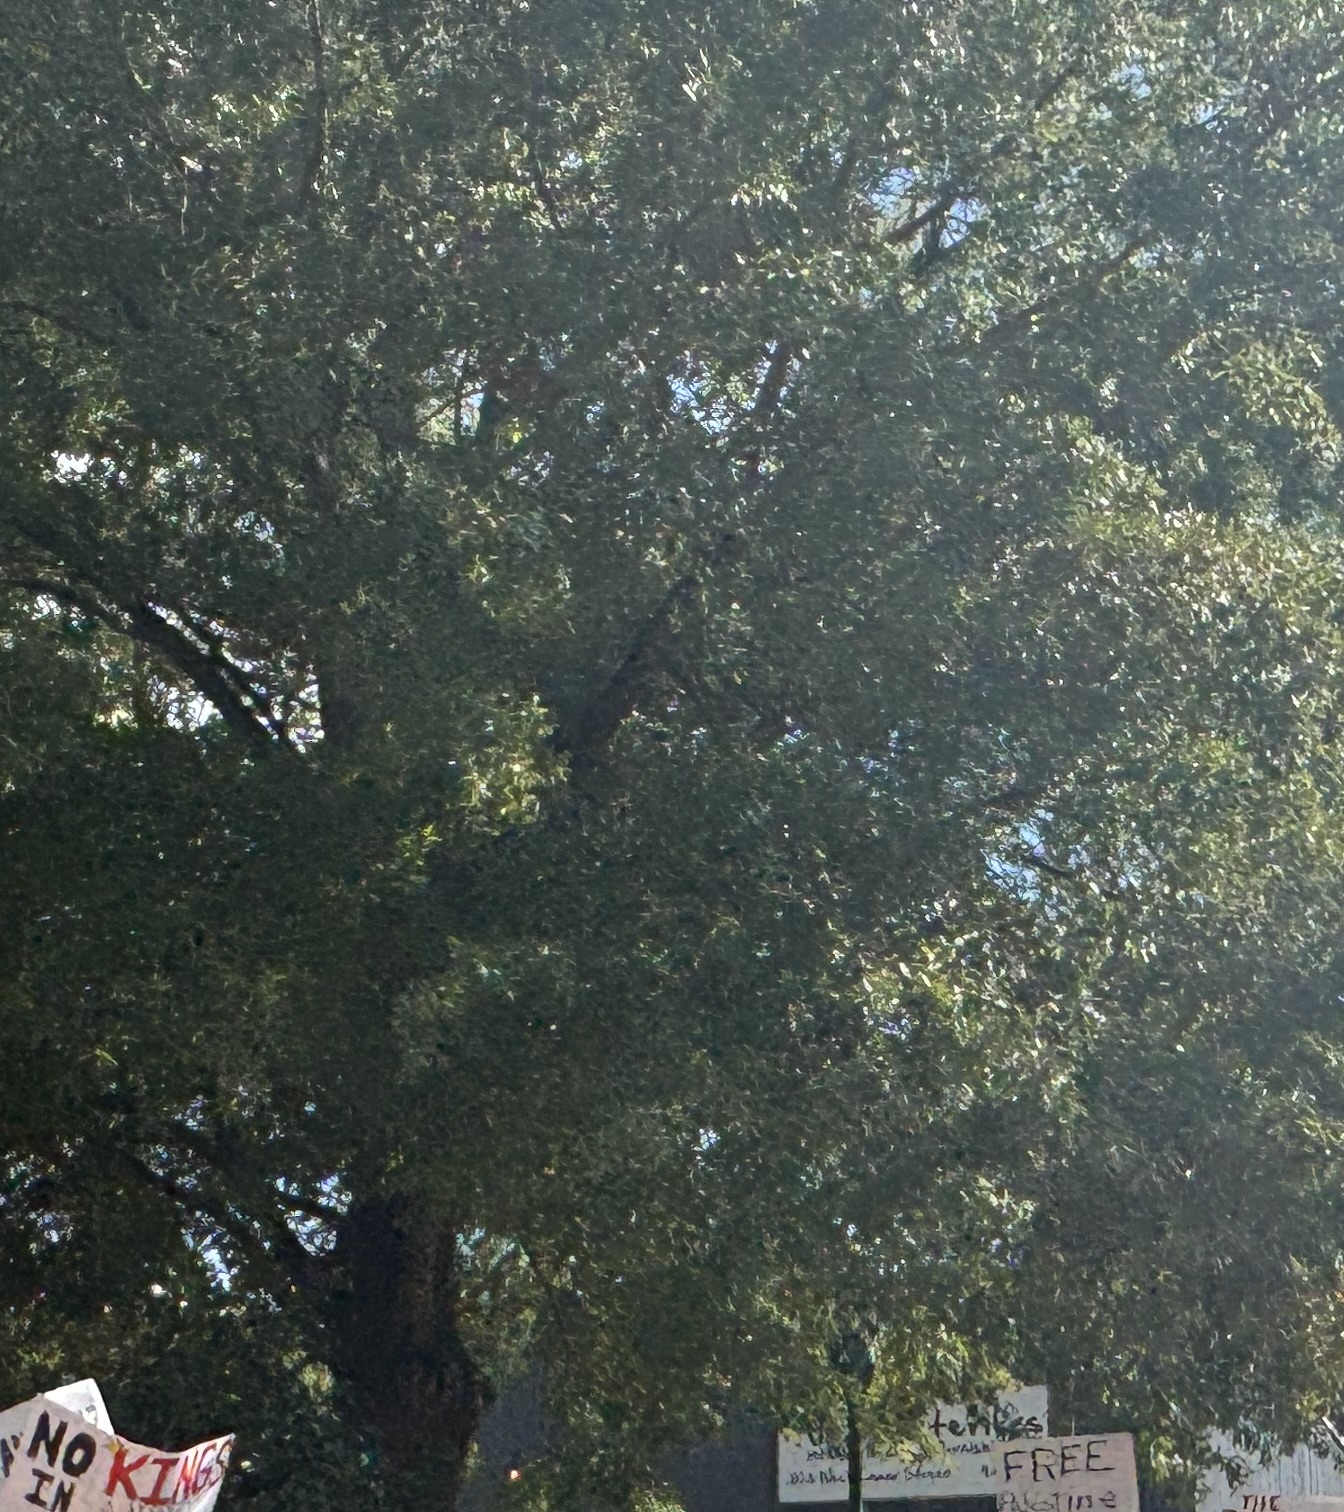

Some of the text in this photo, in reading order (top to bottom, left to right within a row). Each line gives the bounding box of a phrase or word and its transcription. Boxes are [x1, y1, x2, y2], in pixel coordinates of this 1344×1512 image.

[27, 1410, 235, 1506] NO KINGS
[1004, 1440, 1116, 1481] FREE
